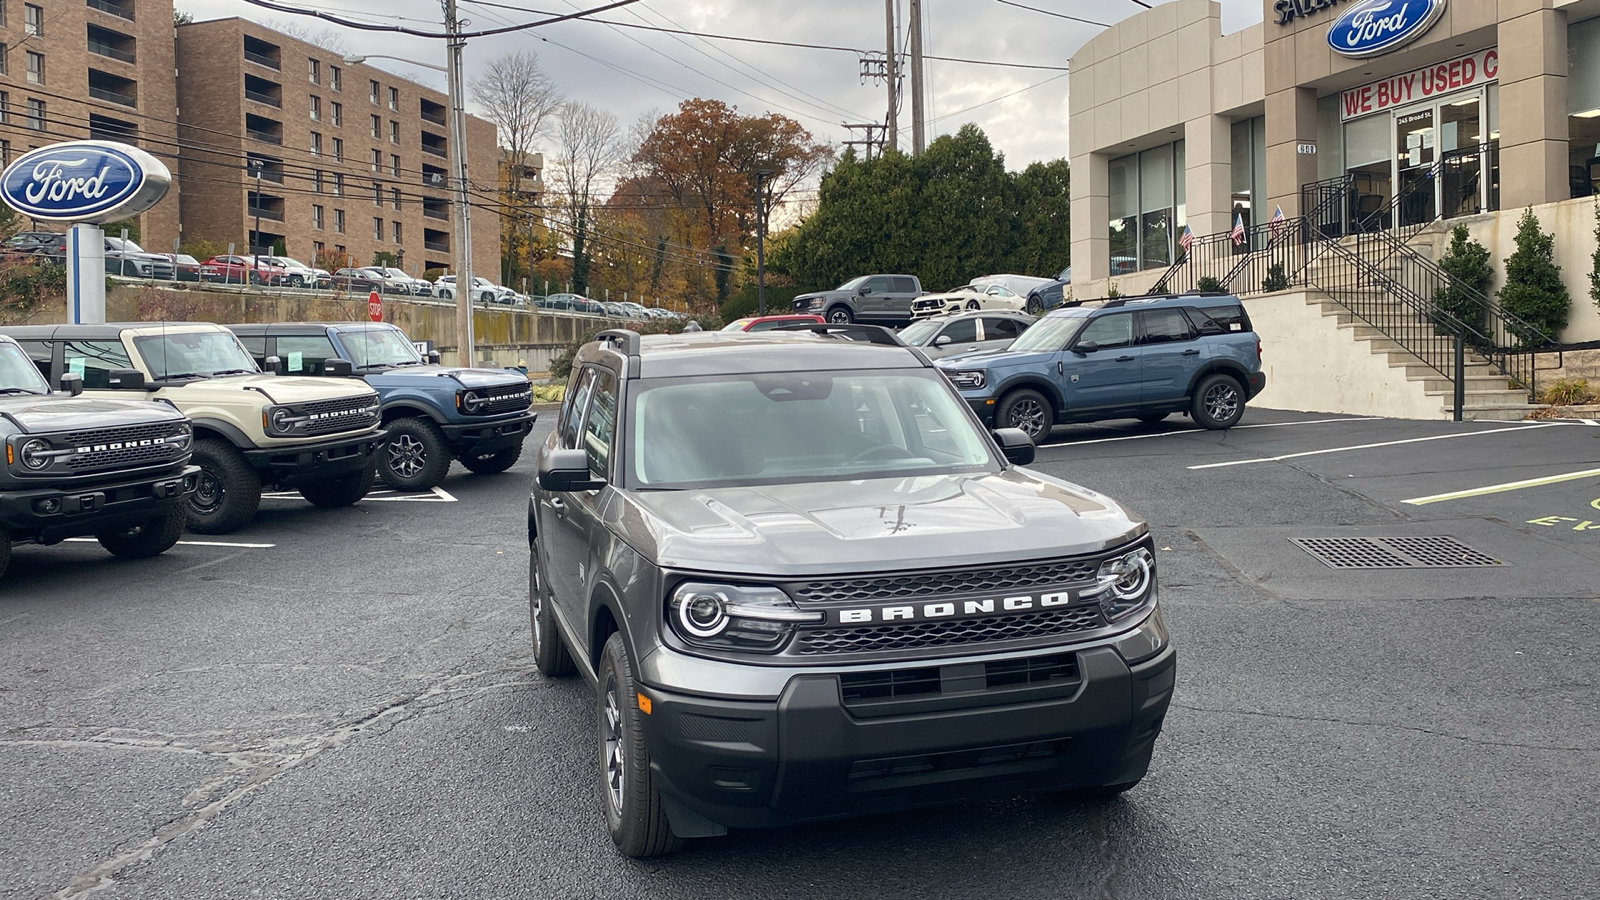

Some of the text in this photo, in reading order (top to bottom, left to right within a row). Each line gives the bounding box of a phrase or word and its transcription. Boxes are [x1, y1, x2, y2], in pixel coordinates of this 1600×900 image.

[1347, 2, 1408, 46] Ford
[1344, 86, 1371, 116] WE
[1378, 74, 1415, 108] BUY
[1422, 57, 1475, 96] USED
[25, 158, 110, 204] Ford
[369, 302, 381, 316] STOP
[489, 392, 525, 402] BRONCO
[310, 407, 366, 420] BRONCO
[77, 437, 165, 453] BRONCO
[839, 591, 1069, 623] BRONCO
